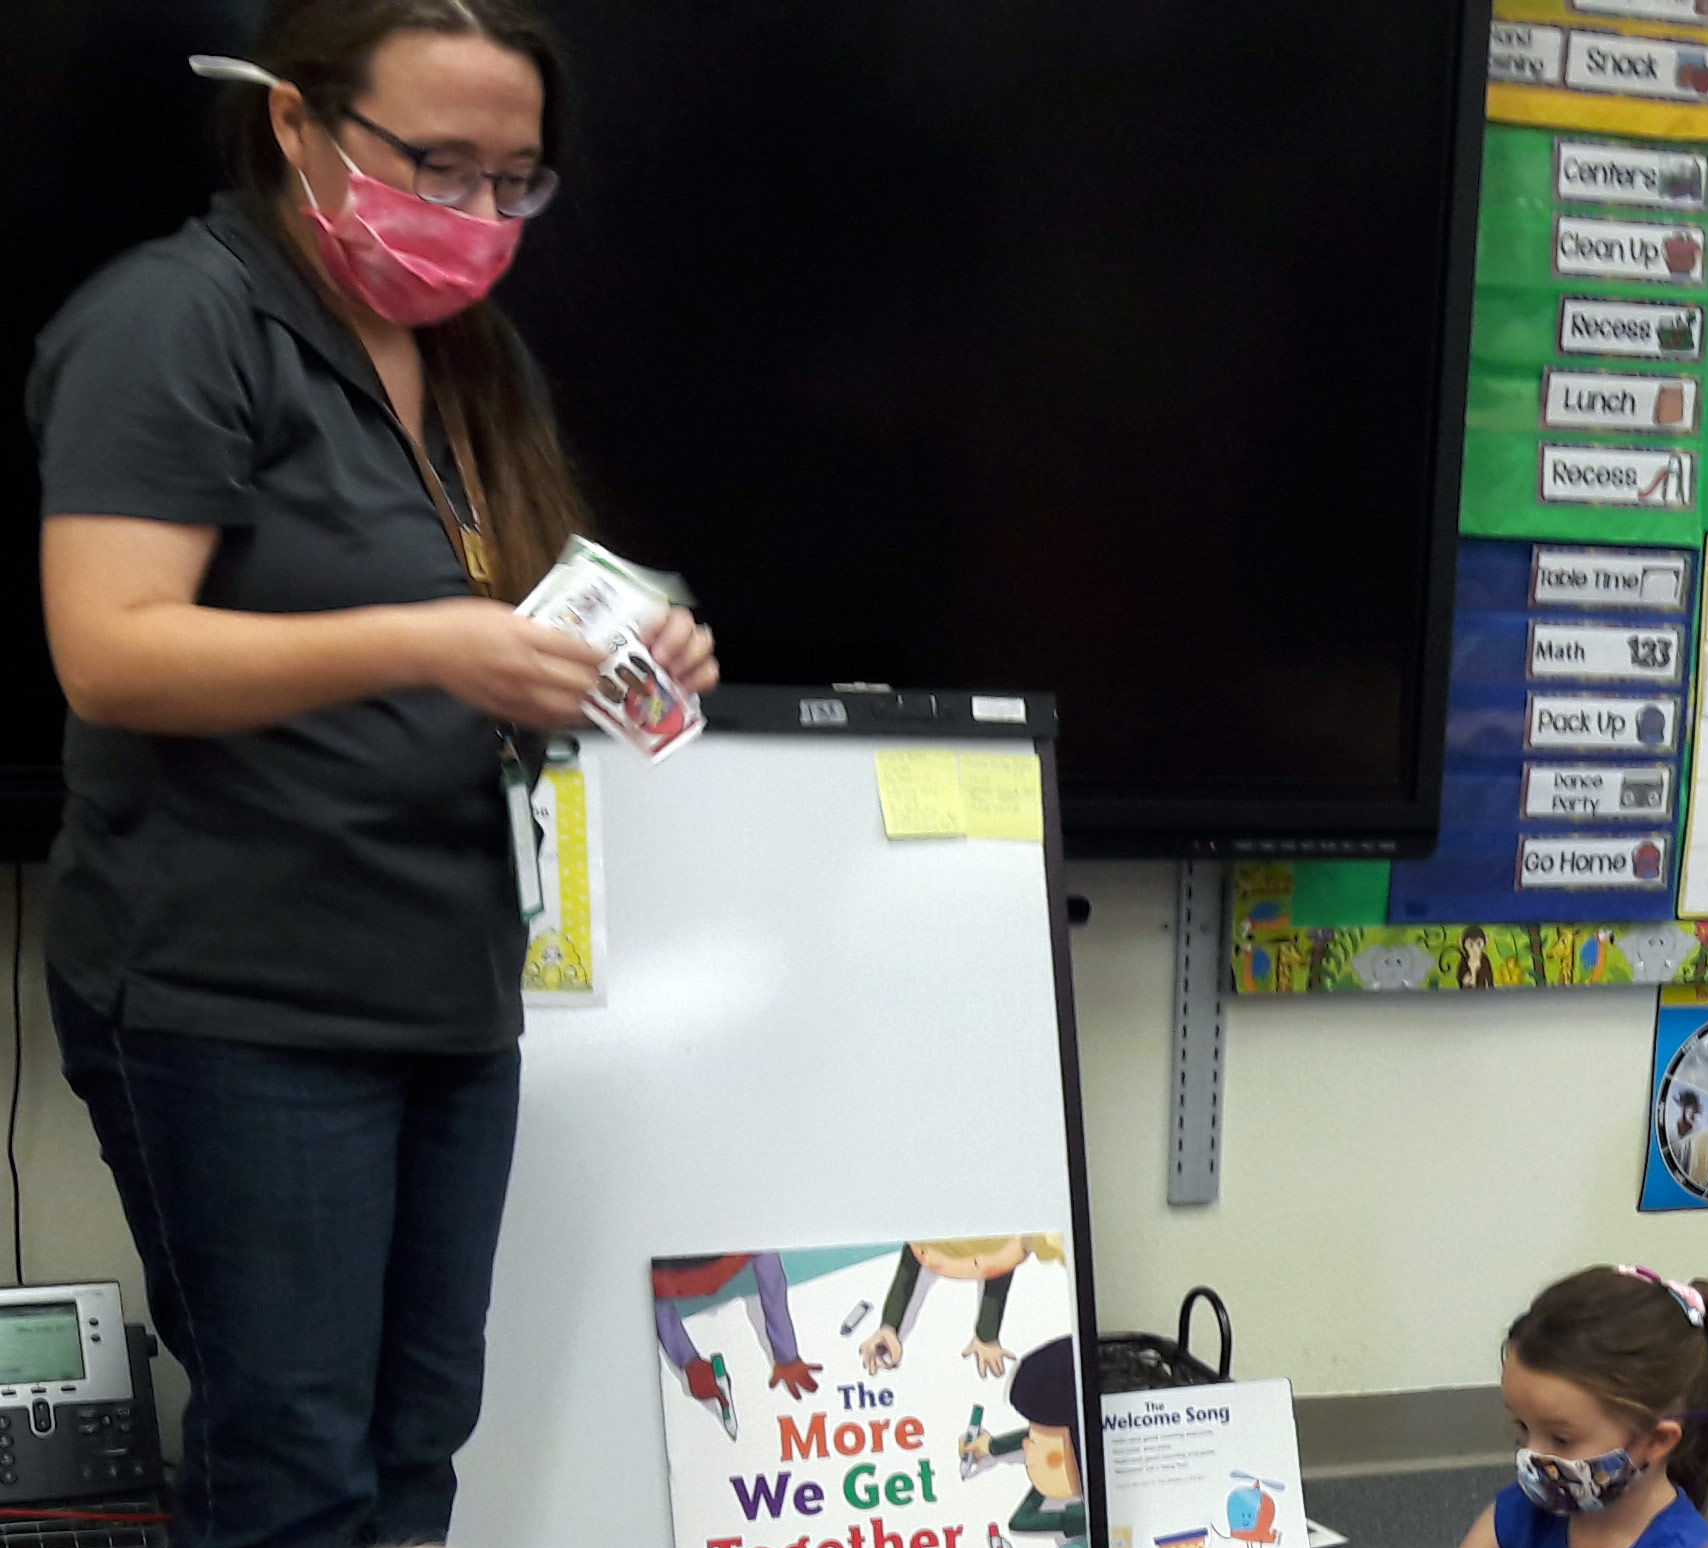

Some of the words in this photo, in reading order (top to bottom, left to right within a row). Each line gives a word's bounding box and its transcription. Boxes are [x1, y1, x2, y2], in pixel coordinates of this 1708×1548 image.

[1586, 47, 1657, 79] Snack
[1564, 157, 1657, 188] Centers
[1561, 231, 1623, 264] Clean
[1630, 238, 1658, 269] Up
[1571, 312, 1651, 340] Recess
[1563, 386, 1636, 415] Lunch
[1553, 459, 1637, 487] Recess
[1540, 568, 1587, 588] Table
[1592, 568, 1639, 589] Time
[1535, 640, 1586, 663] Math
[1538, 709, 1591, 735] Pack
[1597, 710, 1626, 740] Up
[1553, 772, 1603, 790] Dance
[1551, 795, 1600, 817] Party
[1524, 851, 1555, 874] Go
[1560, 850, 1628, 874] Home
[837, 1382, 895, 1411] The
[1145, 1401, 1165, 1412] The
[1186, 1405, 1231, 1426] Song
[777, 1411, 925, 1463] More
[729, 1471, 825, 1521] We
[843, 1458, 938, 1510] Get
